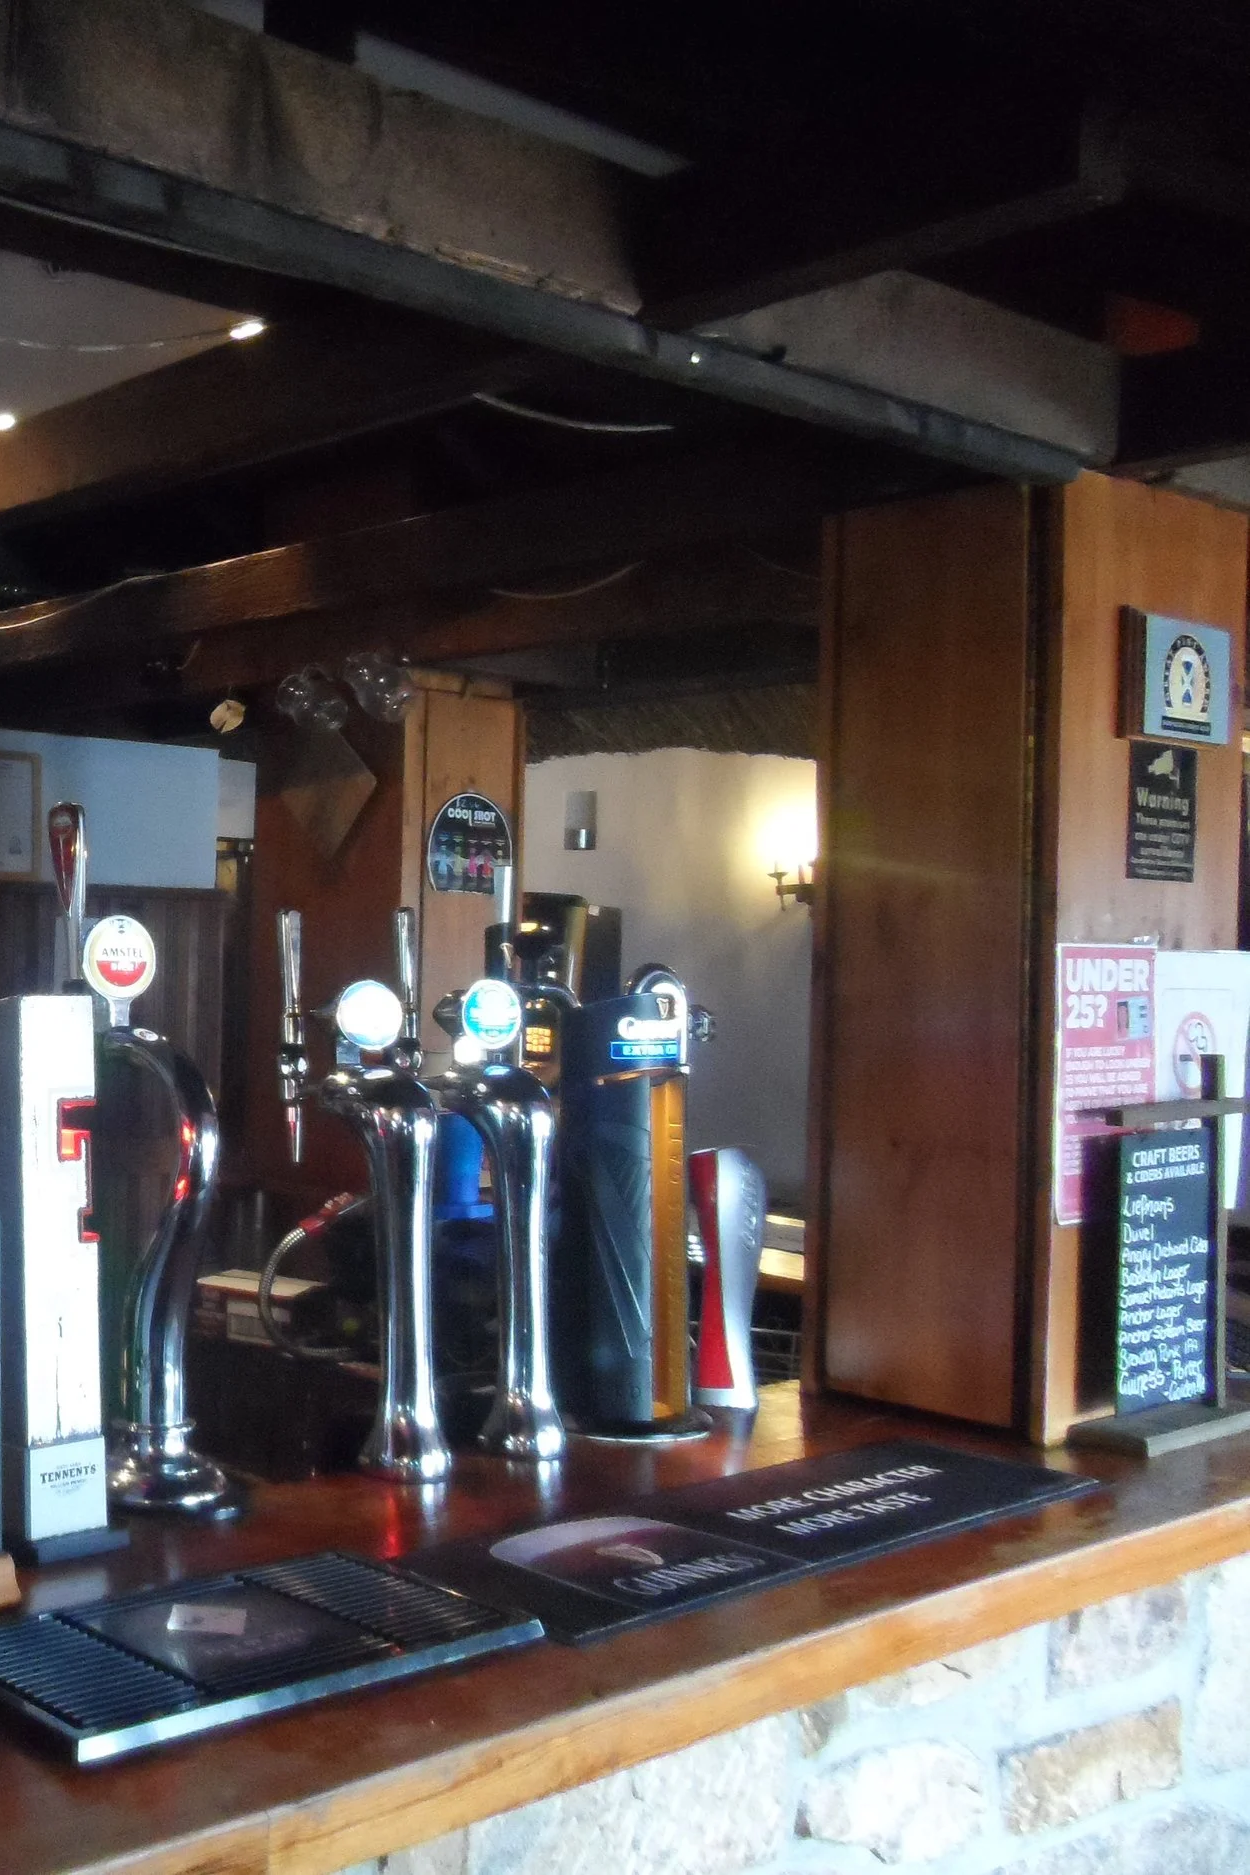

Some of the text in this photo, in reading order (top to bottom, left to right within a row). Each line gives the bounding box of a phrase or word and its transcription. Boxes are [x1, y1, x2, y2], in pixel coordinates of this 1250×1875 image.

[1136, 787, 1190, 816] Warning
[101, 947, 143, 958] AMSTEL
[1065, 958, 1149, 993] UNDER
[1065, 994, 1109, 1029] 25?
[1132, 1145, 1200, 1168] CRAFT BEERS
[1164, 1162, 1205, 1179] AVAILABLE
[1123, 1223, 1154, 1243] Duvel
[727, 1463, 943, 1523] MORE CHARACTER
[775, 1490, 932, 1538] MORE TASTE
[612, 1551, 766, 1595] GUINNESS
